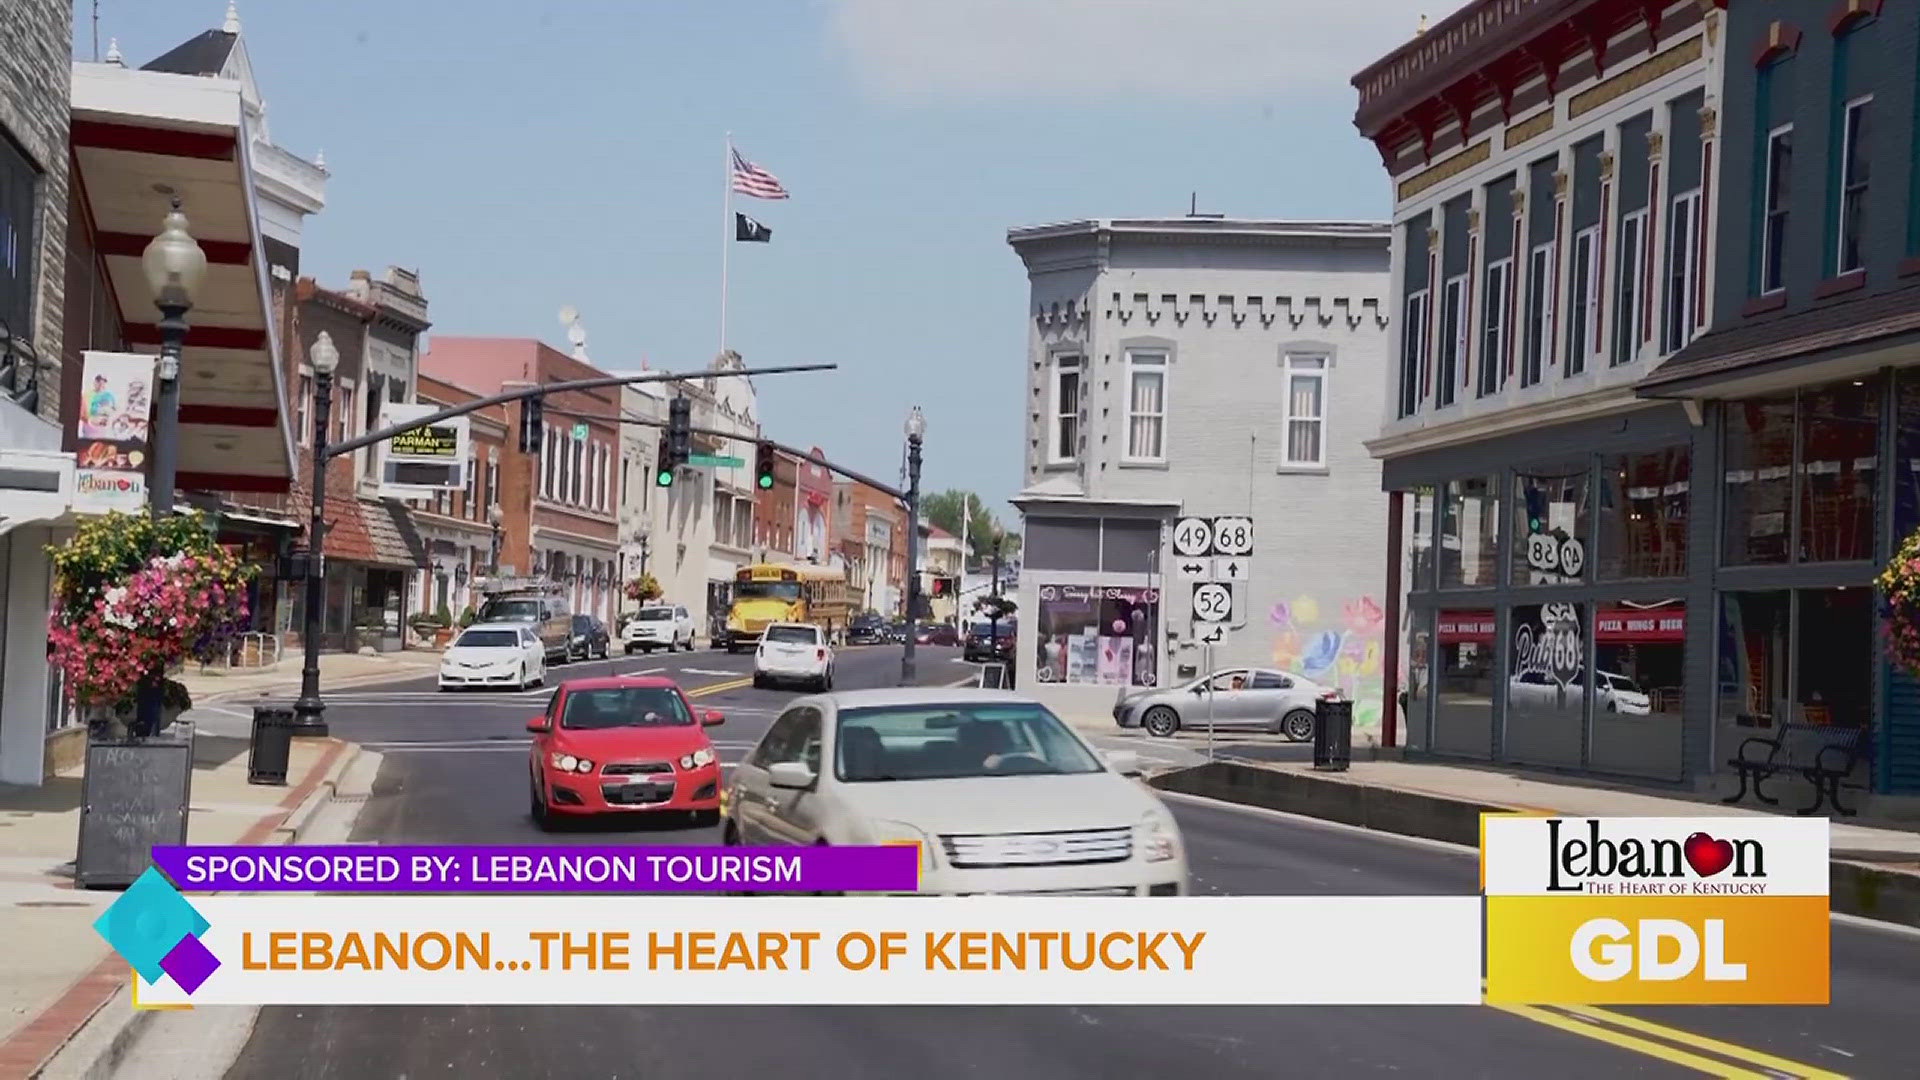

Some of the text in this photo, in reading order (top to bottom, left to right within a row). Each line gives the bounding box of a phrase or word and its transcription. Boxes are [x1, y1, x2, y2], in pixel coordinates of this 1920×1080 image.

[393, 436, 439, 447] PARMAN
[1180, 526, 1206, 548] 49
[1220, 526, 1245, 548] 68
[1200, 591, 1225, 613] 52
[1598, 619, 1622, 632] PIZZA
[1555, 630, 1576, 671] 68
